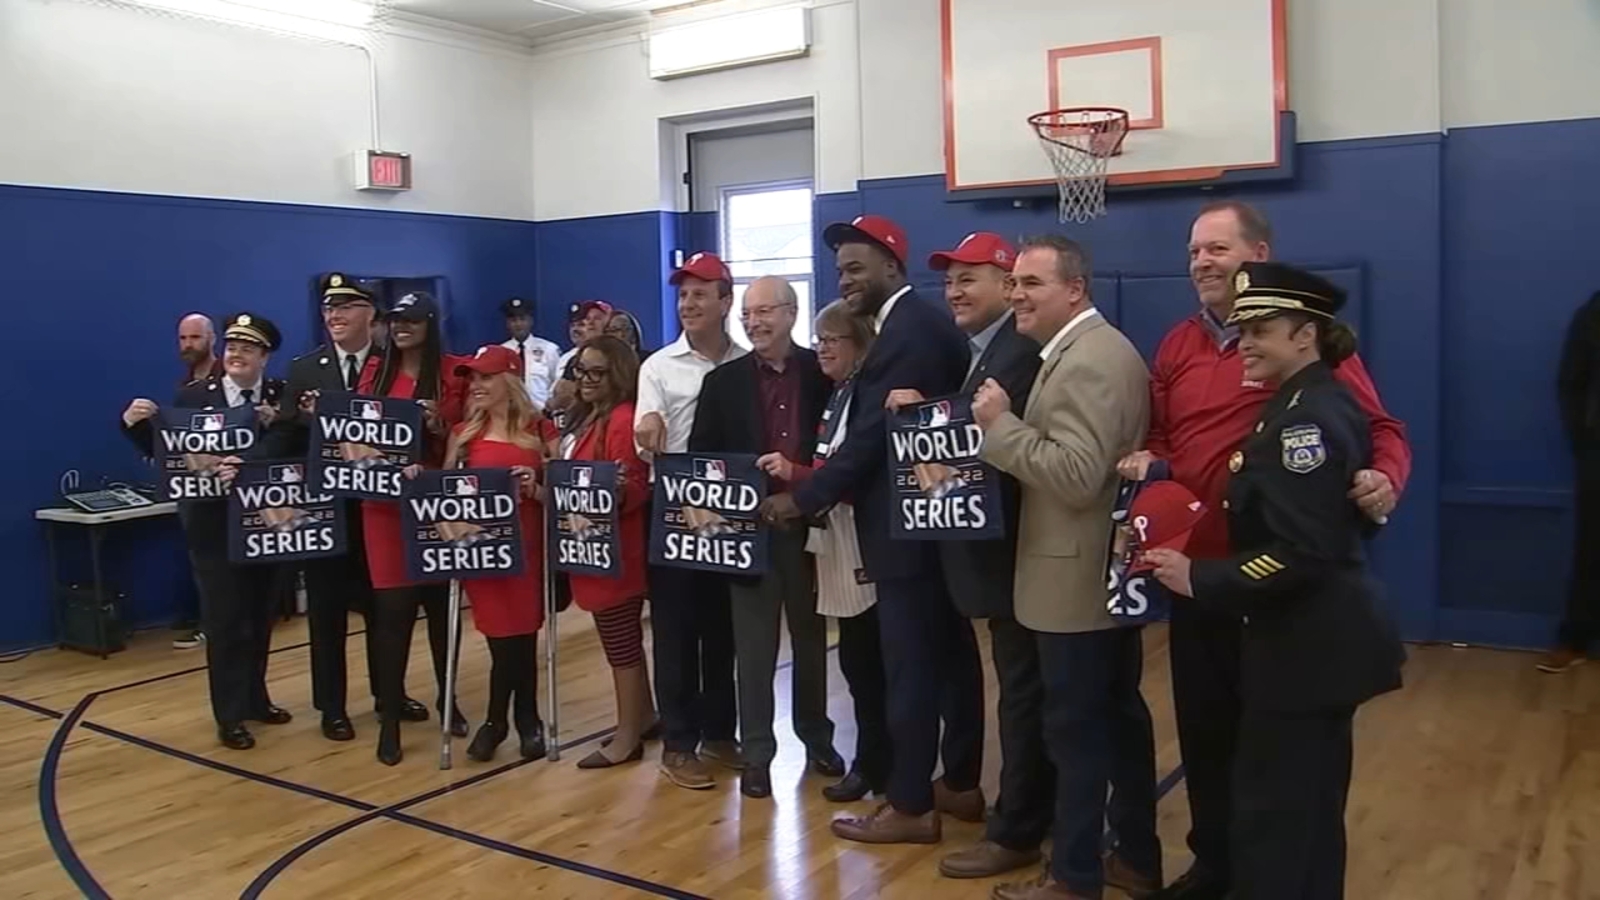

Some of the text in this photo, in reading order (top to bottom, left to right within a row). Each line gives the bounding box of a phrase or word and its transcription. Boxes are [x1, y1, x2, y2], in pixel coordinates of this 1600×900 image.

[160, 428, 254, 452] WORLD
[320, 416, 412, 446] WORLD
[892, 424, 984, 461] WORLD
[1283, 434, 1320, 451] POLICE
[169, 476, 232, 499] SERI
[323, 466, 401, 496] SERIES
[896, 469, 984, 486] 20 22
[410, 494, 514, 521] WORLD
[553, 486, 613, 514] WORLD
[662, 475, 759, 511] WORLD
[902, 494, 987, 530] SERIES
[246, 527, 334, 557] SERIES
[1134, 515, 1149, 542] P
[422, 544, 512, 573] SERIES
[559, 538, 611, 569] SERIES
[664, 532, 752, 569] SERIES
